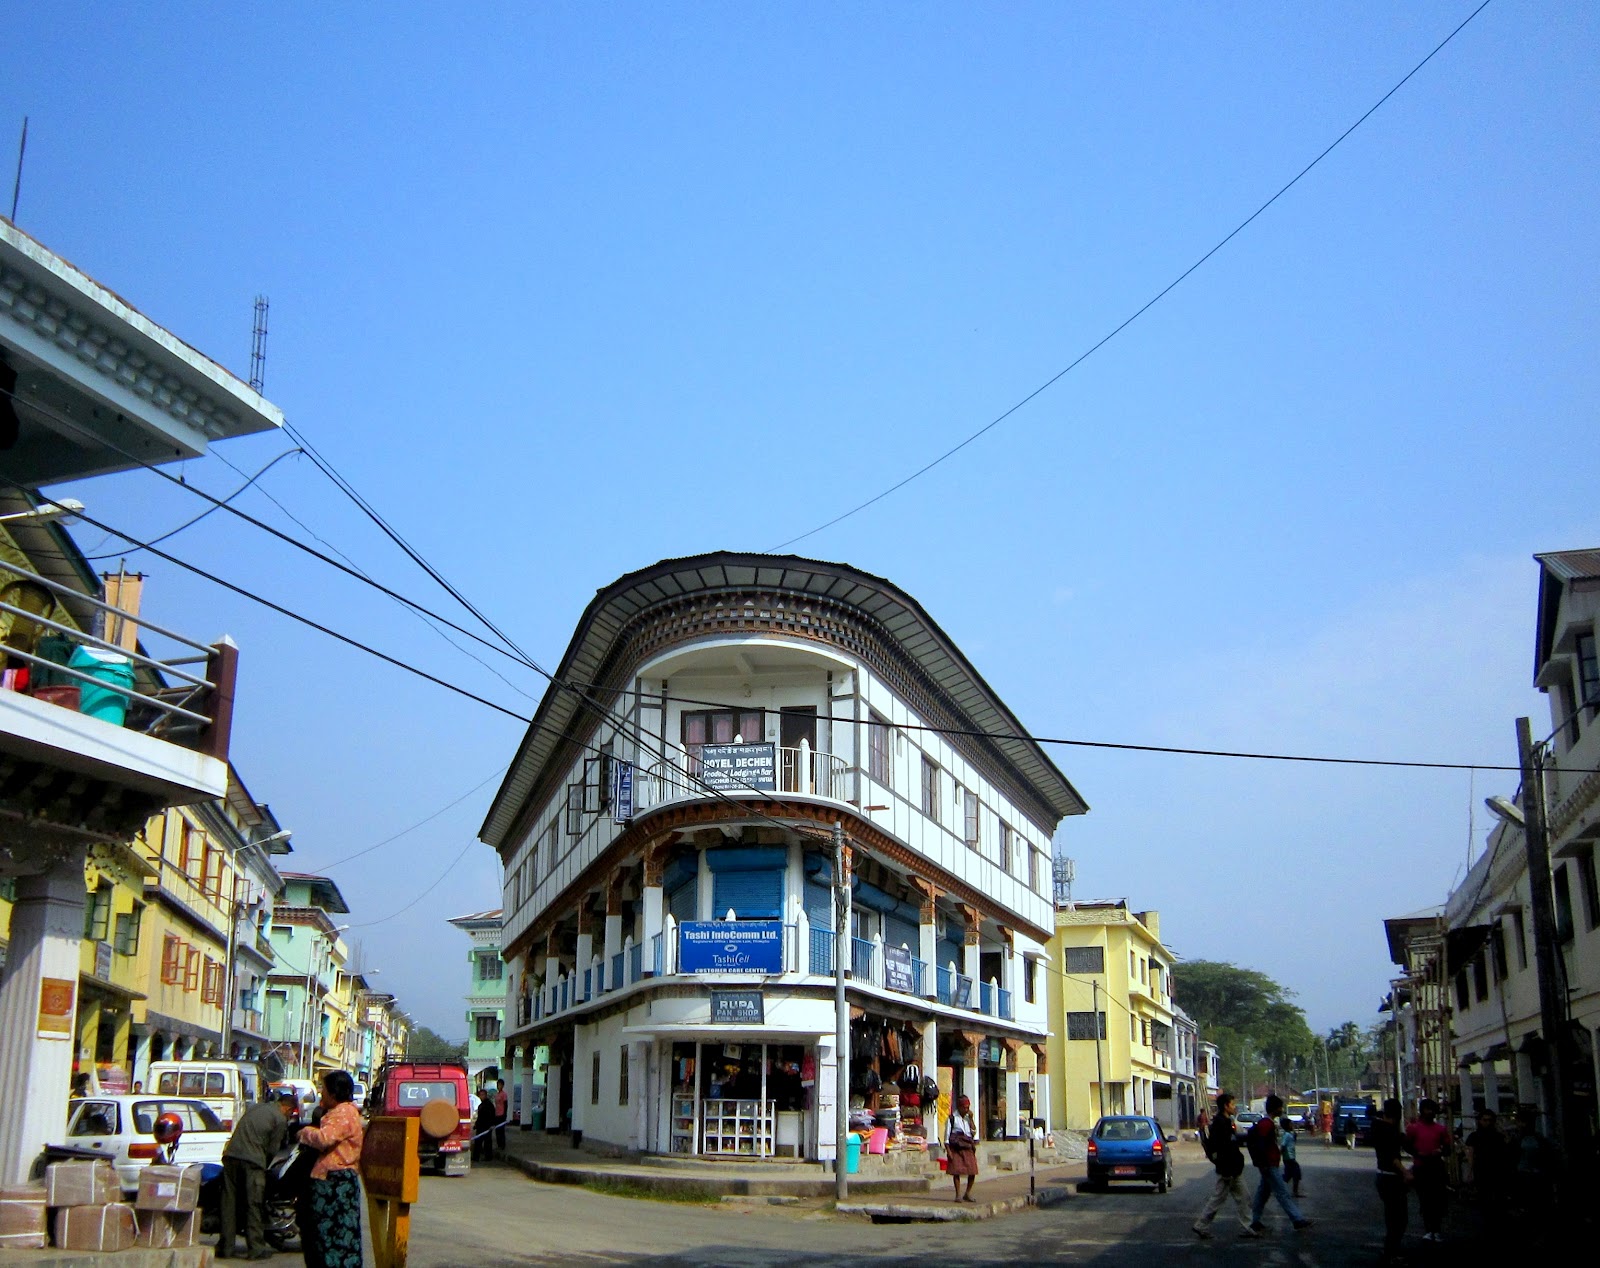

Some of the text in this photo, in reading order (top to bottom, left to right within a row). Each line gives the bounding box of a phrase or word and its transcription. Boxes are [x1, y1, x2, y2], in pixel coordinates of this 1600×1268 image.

[704, 757, 772, 769] HOTEL DECHEN
[761, 768, 773, 776] Bar
[684, 931, 779, 940] Tashi InfoComm Ltd.
[712, 952, 750, 966] TashiCell
[719, 1000, 755, 1010] RUPA
